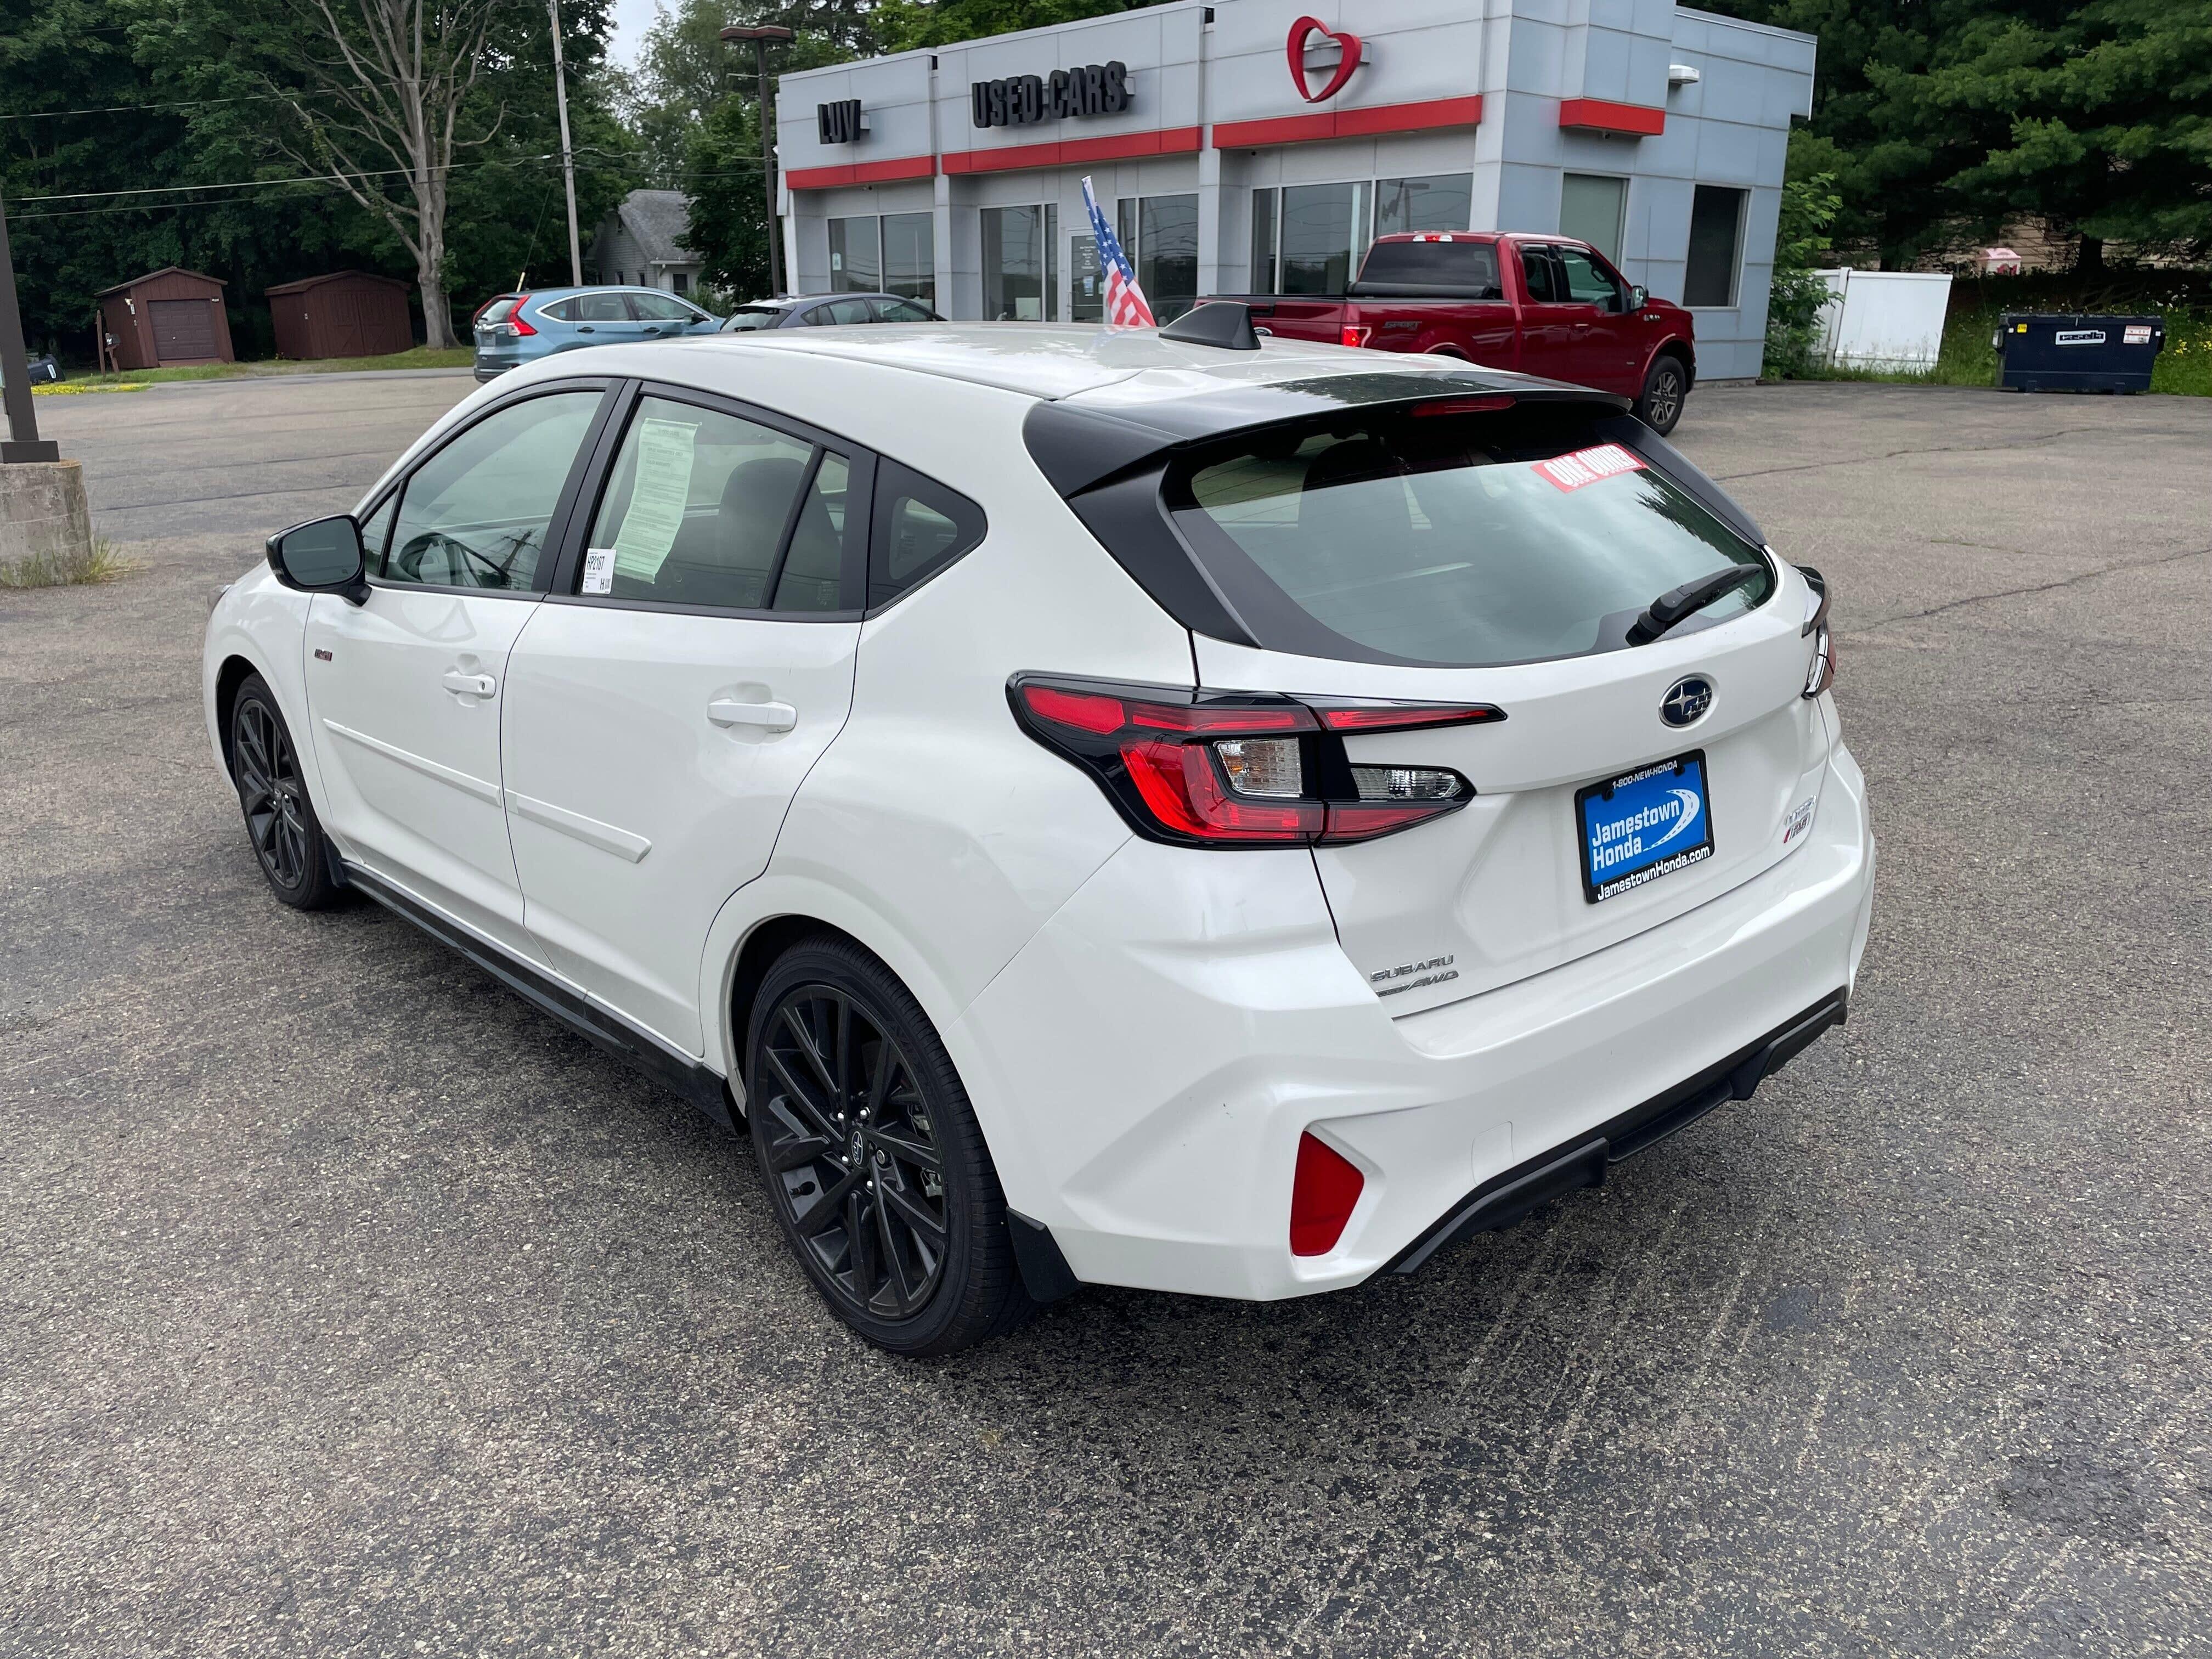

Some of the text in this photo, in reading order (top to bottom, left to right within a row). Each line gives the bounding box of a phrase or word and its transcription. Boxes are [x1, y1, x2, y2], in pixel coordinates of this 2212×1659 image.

[972, 61, 1127, 128] USED CARS
[817, 99, 861, 144] LUV
[1543, 445, 1643, 488] ONE OWNER
[586, 556, 605, 570] HP2107
[600, 578, 605, 590] H
[1612, 760, 1678, 789] 1-800-NEW-HONDA
[1593, 800, 1680, 847] Jamestown
[1593, 834, 1642, 872] Honda
[1598, 846, 1710, 900] JamestownHonda.com
[1370, 953, 1454, 982] SUBARU
[1405, 970, 1459, 992] AWD
